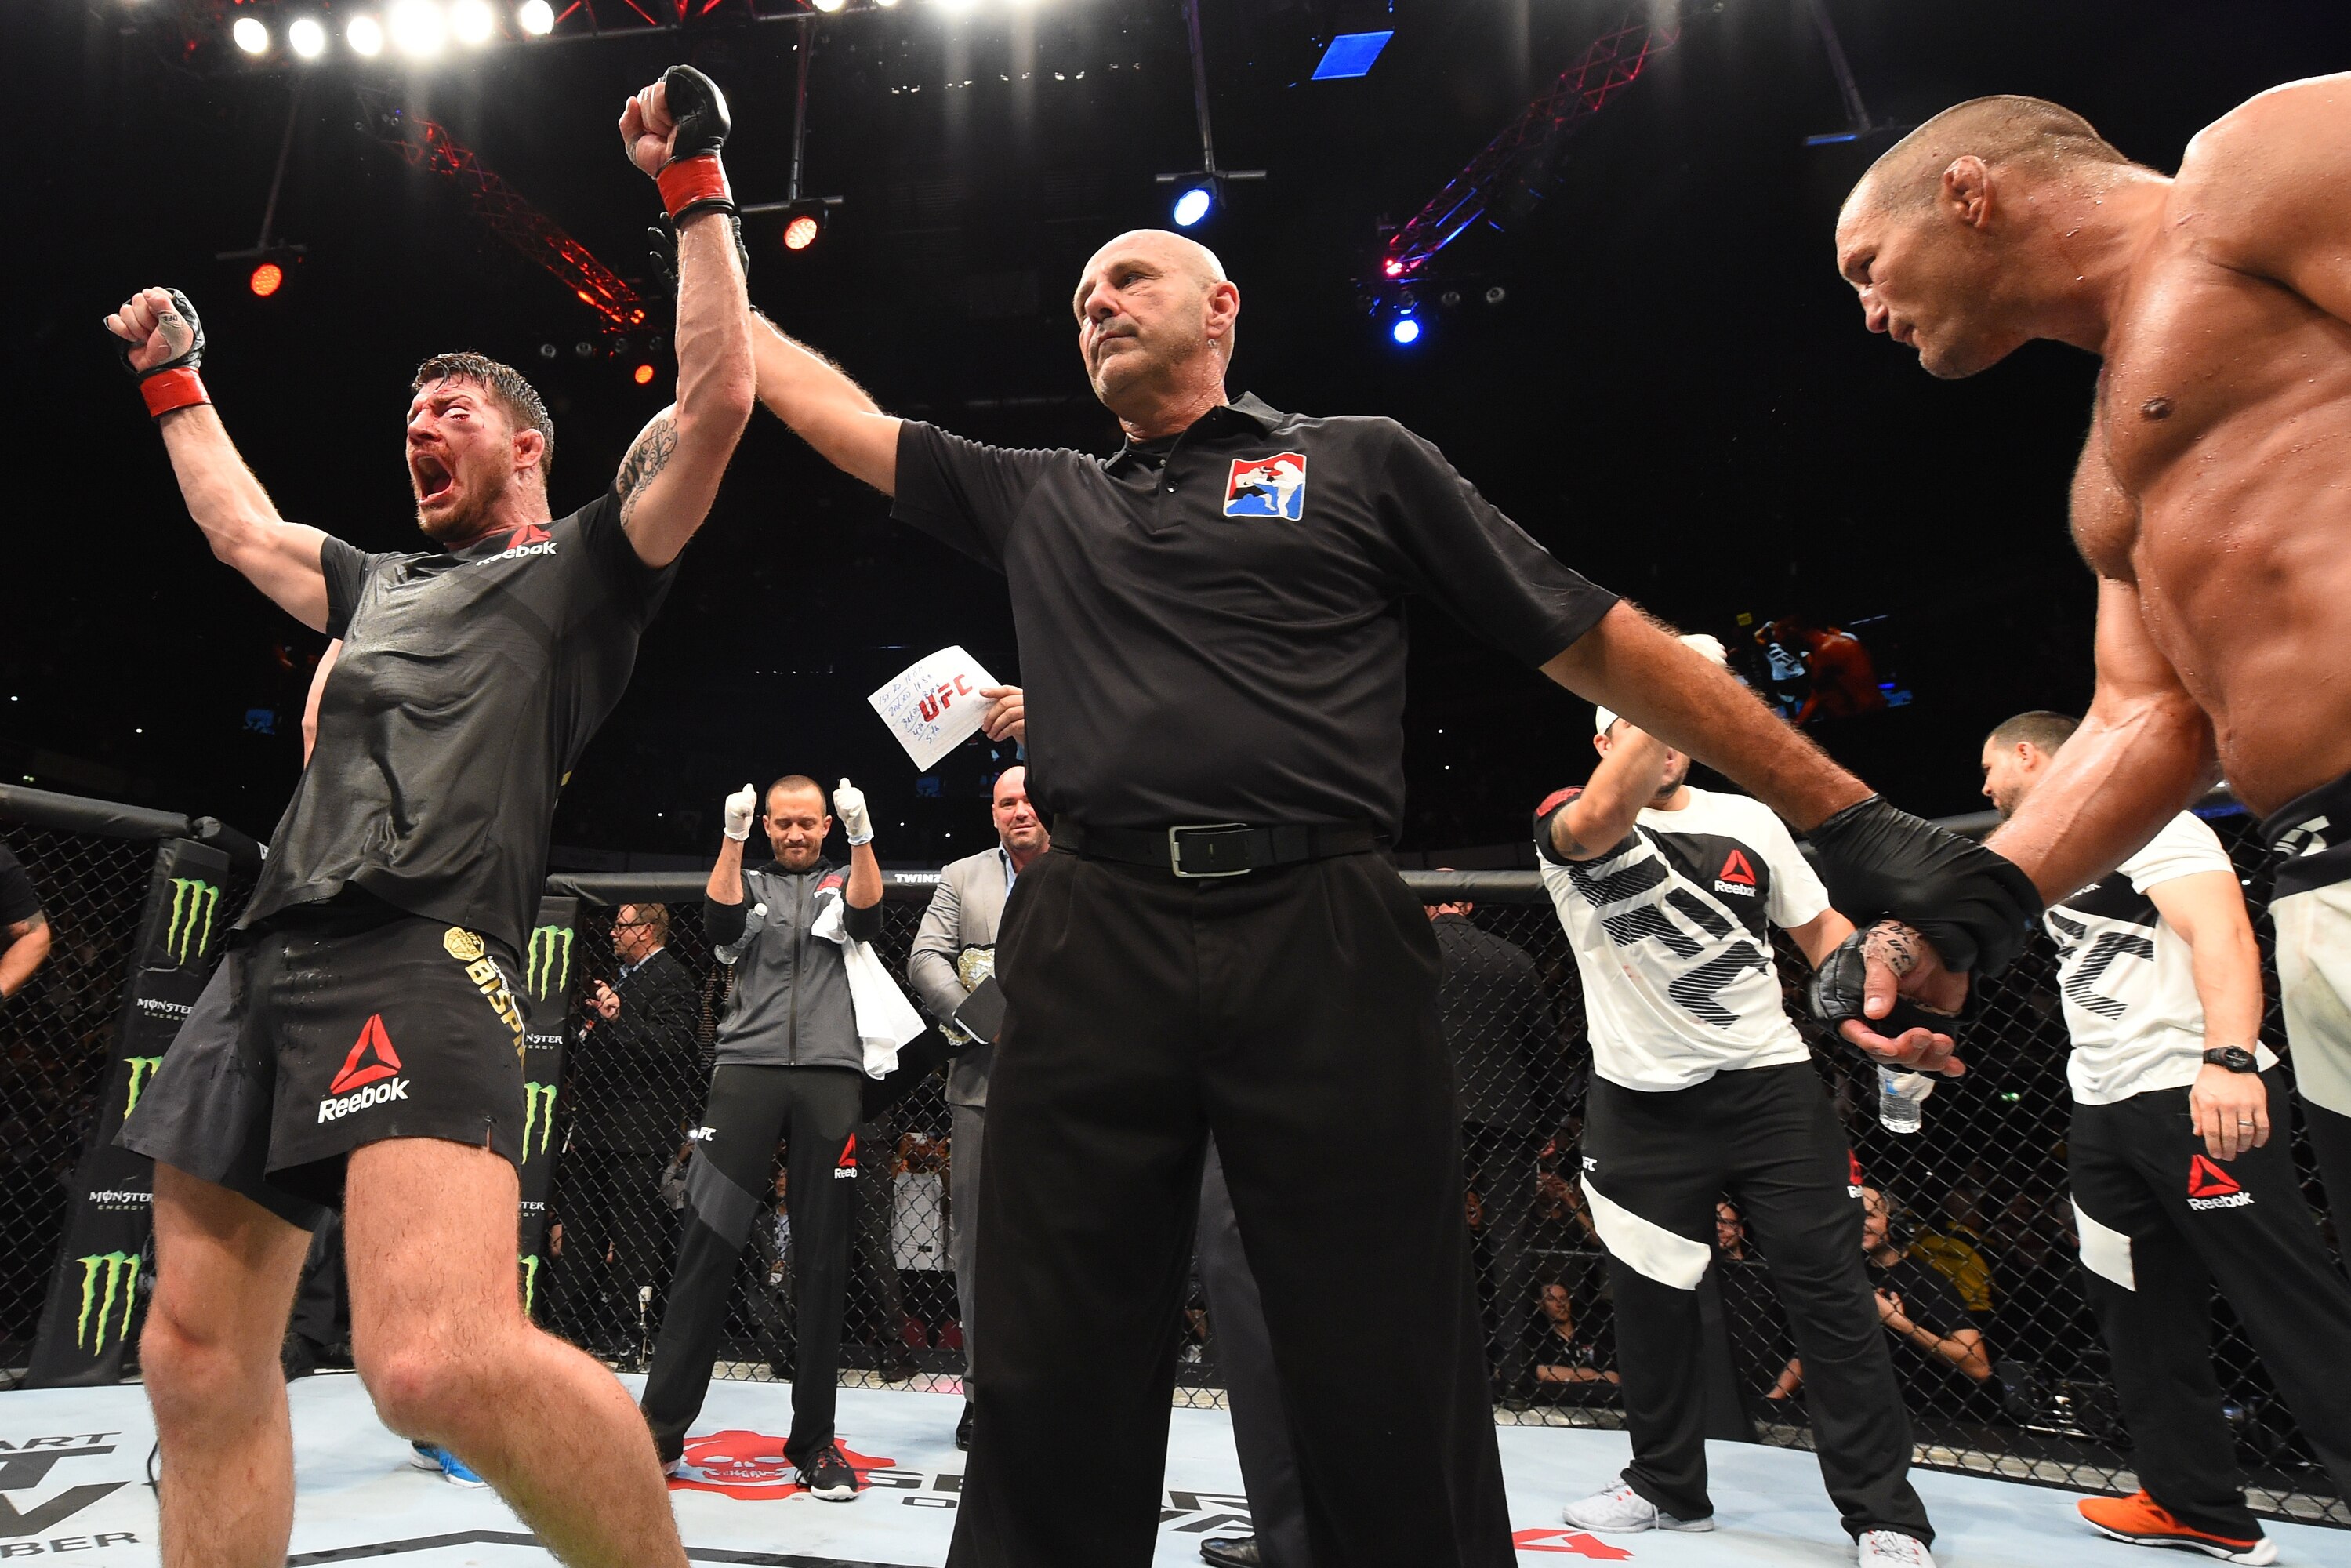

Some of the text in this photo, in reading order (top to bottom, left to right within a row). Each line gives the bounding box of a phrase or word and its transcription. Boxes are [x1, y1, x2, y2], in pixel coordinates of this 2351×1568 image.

[919, 674, 973, 722] UFC
[318, 1077, 410, 1123] Reebok
[697, 1127, 717, 1141] FC
[834, 1167, 858, 1179] Reeb
[2186, 1192, 2255, 1210] Reebok
